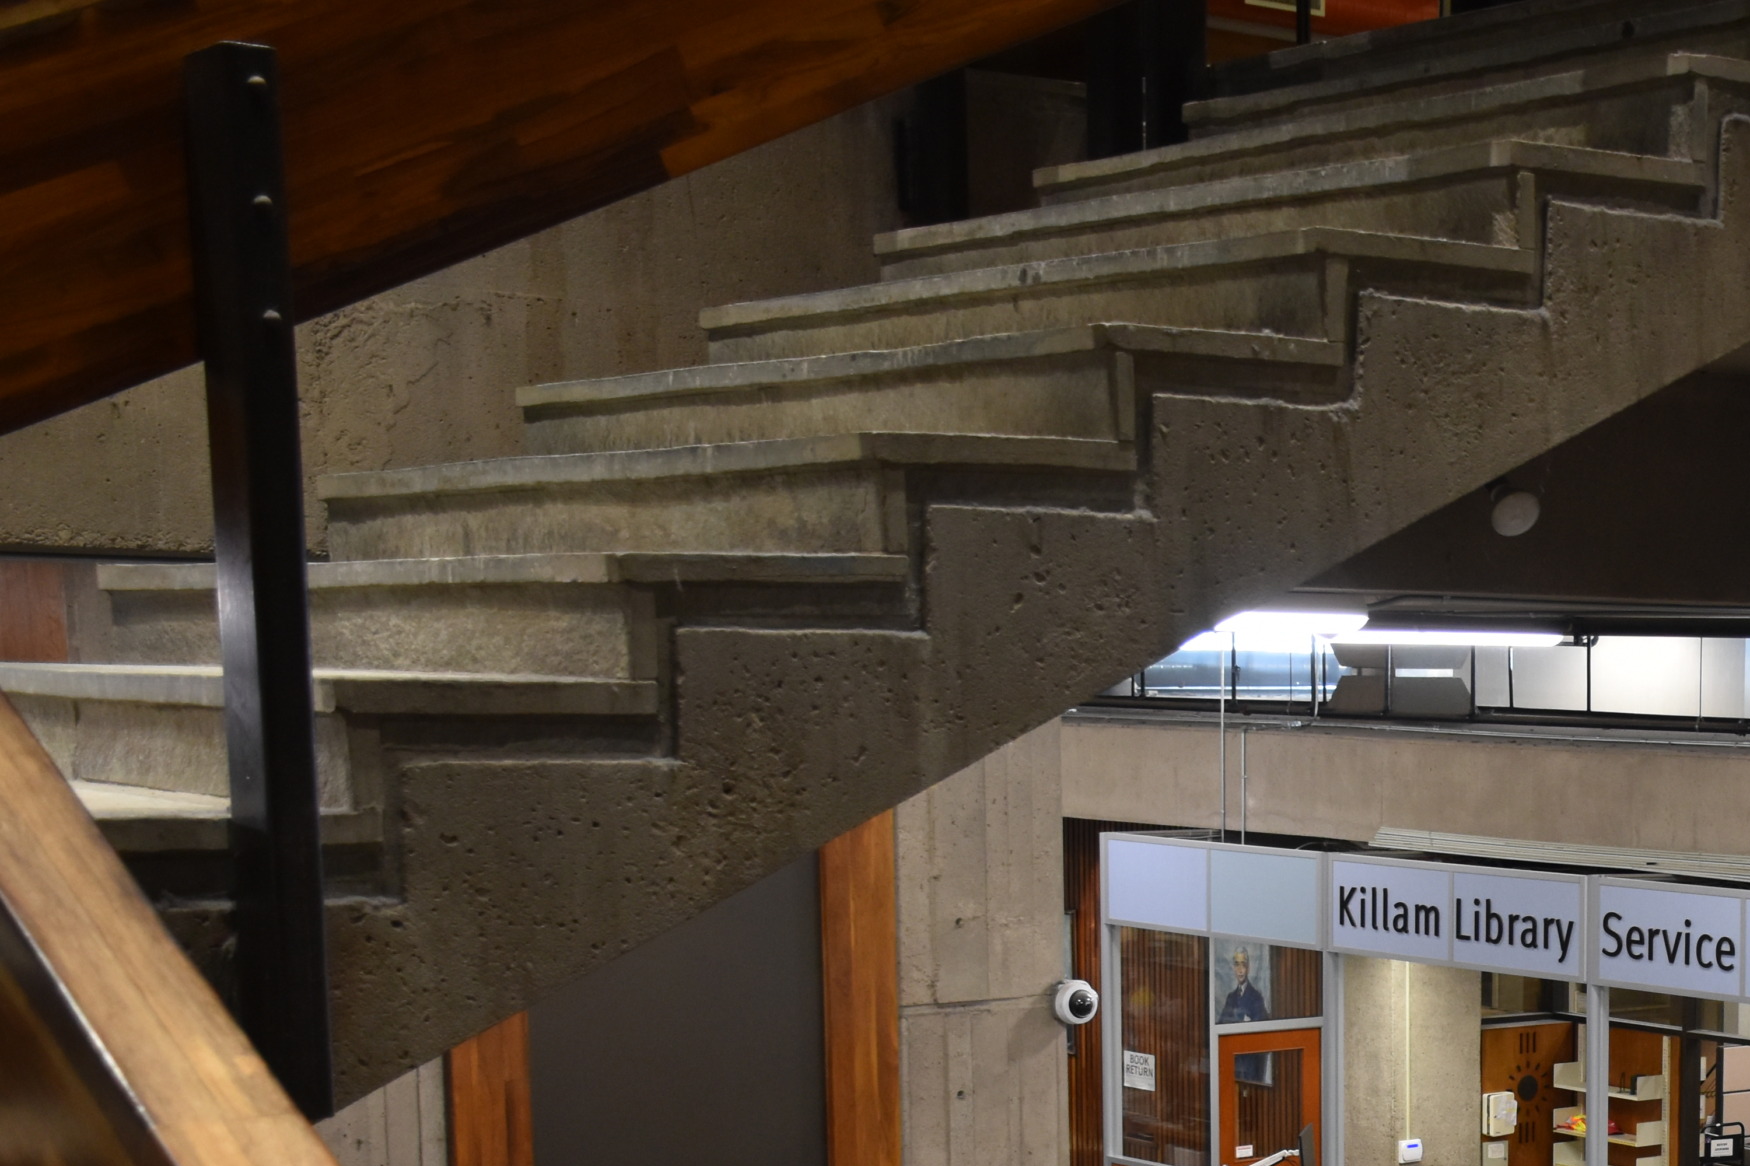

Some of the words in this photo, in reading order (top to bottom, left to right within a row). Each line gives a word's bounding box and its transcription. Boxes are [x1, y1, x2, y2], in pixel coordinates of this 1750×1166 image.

[1338, 885, 1440, 938] Killam
[1454, 897, 1574, 963] Library
[1602, 911, 1735, 971] Service
[1130, 1054, 1149, 1065] BOOK
[1126, 1064, 1153, 1078] RETURN
